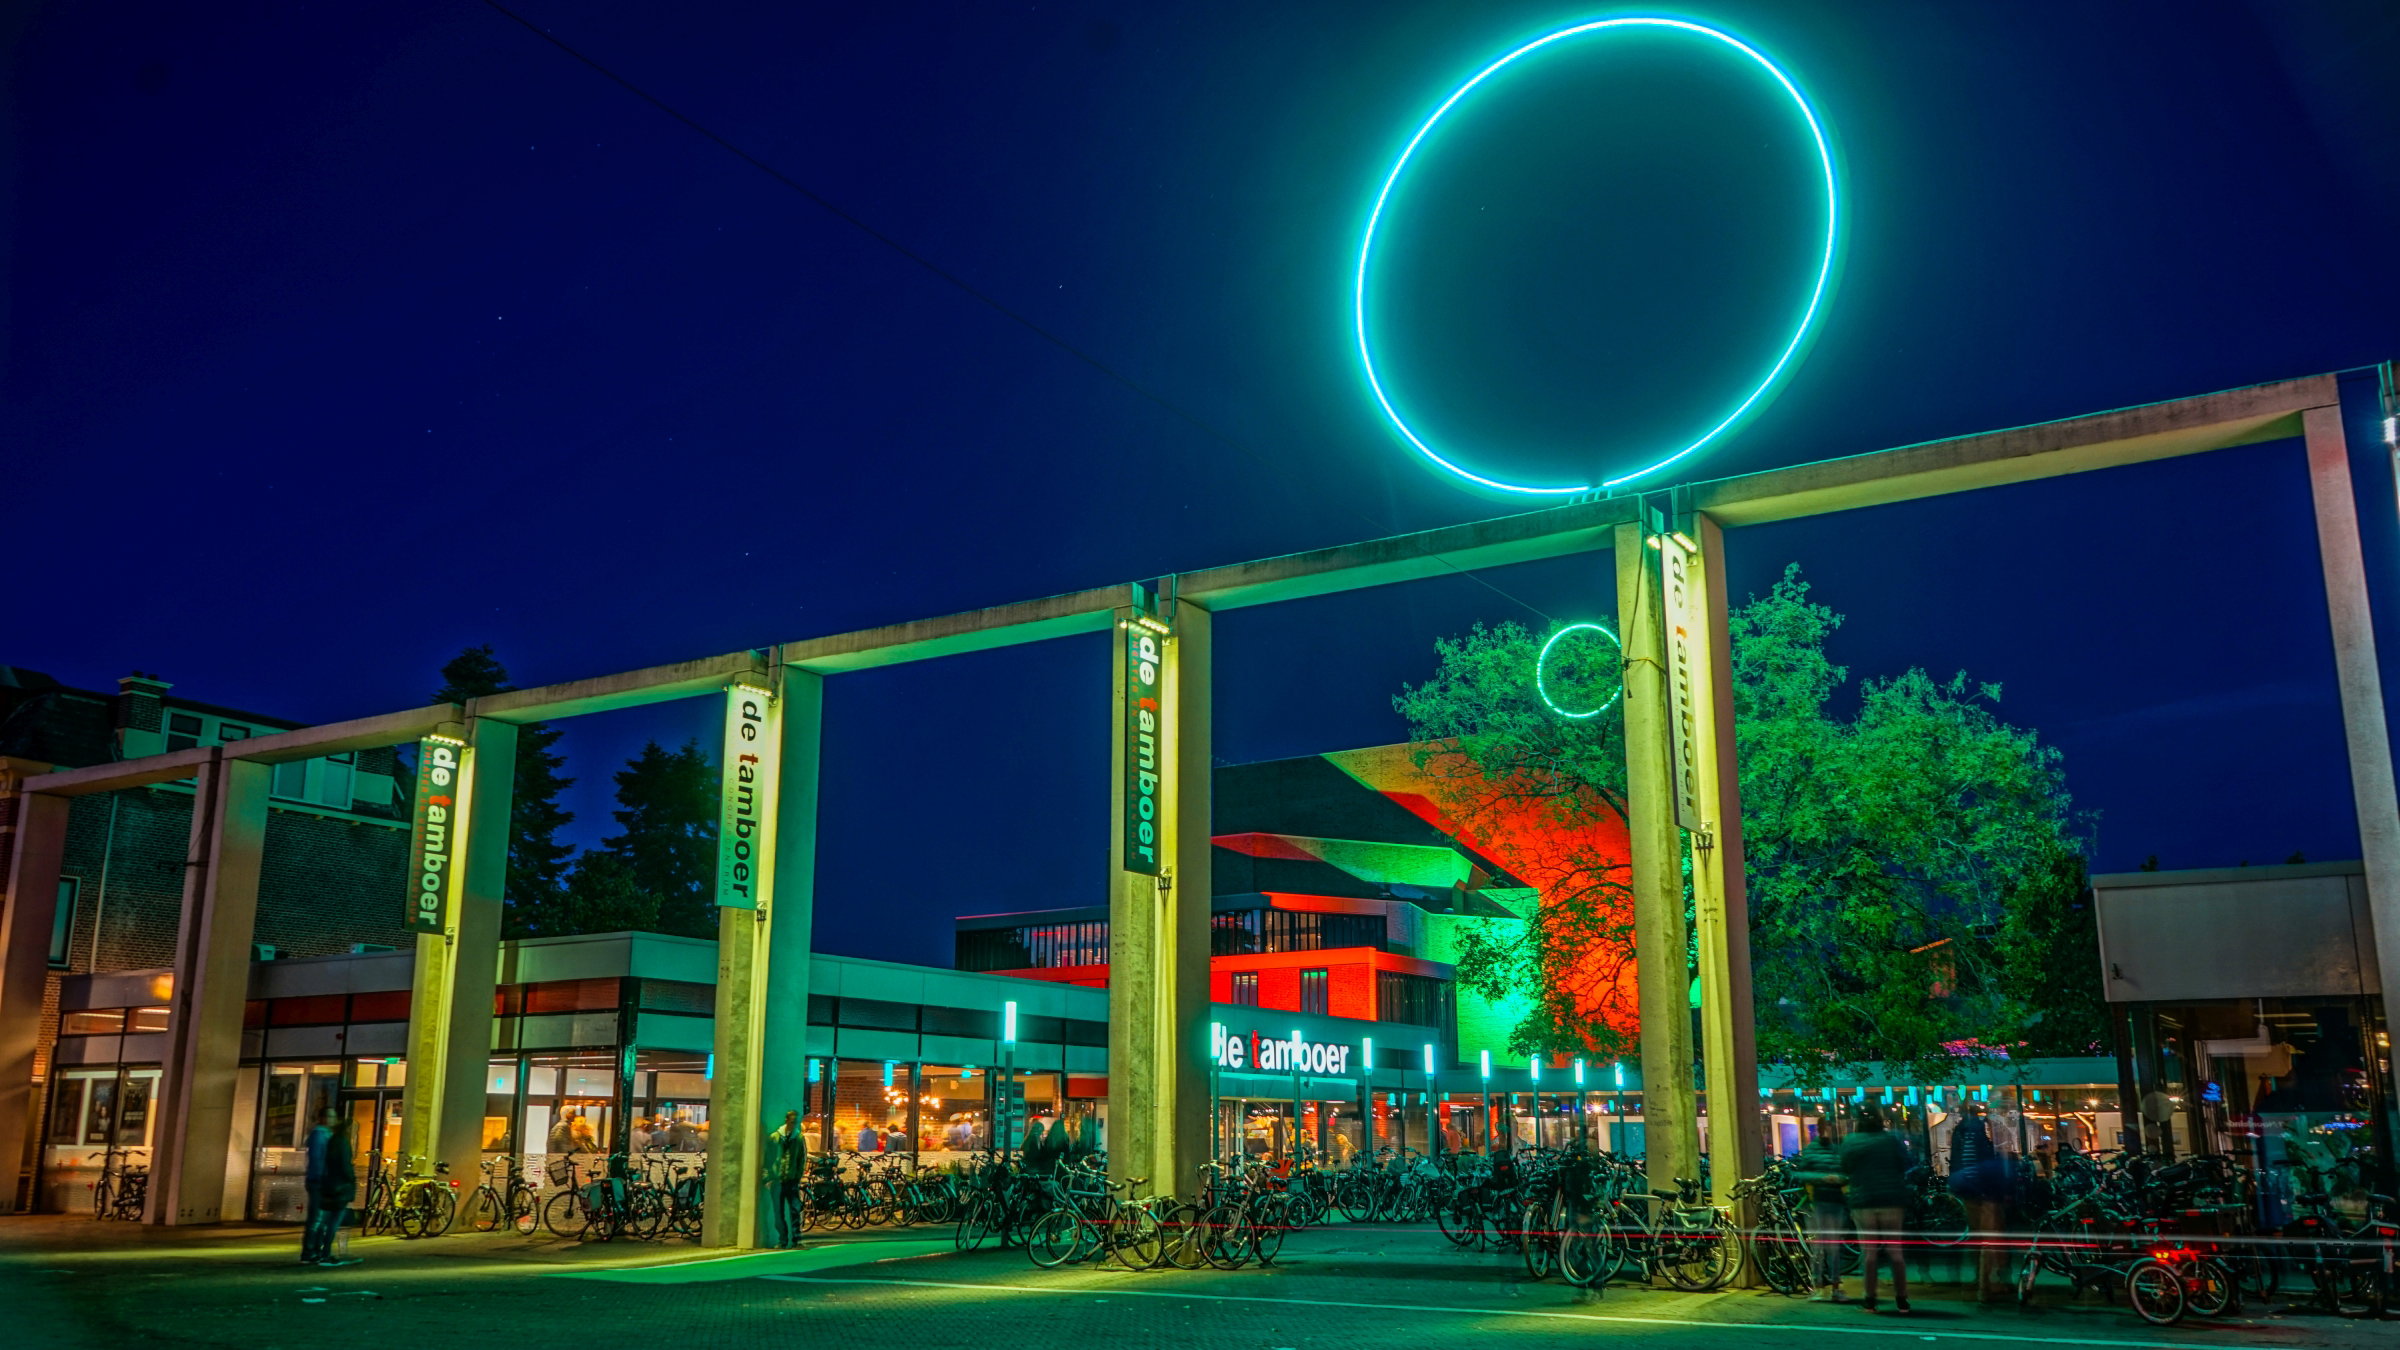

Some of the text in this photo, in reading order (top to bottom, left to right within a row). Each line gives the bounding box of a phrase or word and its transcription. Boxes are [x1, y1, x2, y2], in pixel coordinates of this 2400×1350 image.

[1139, 636, 1159, 864] de tamboer
[1672, 555, 1697, 818] de tamboer
[419, 747, 457, 925] de tamboer
[732, 700, 762, 899] de tamboer
[1251, 1029, 1349, 1074] tamboer
